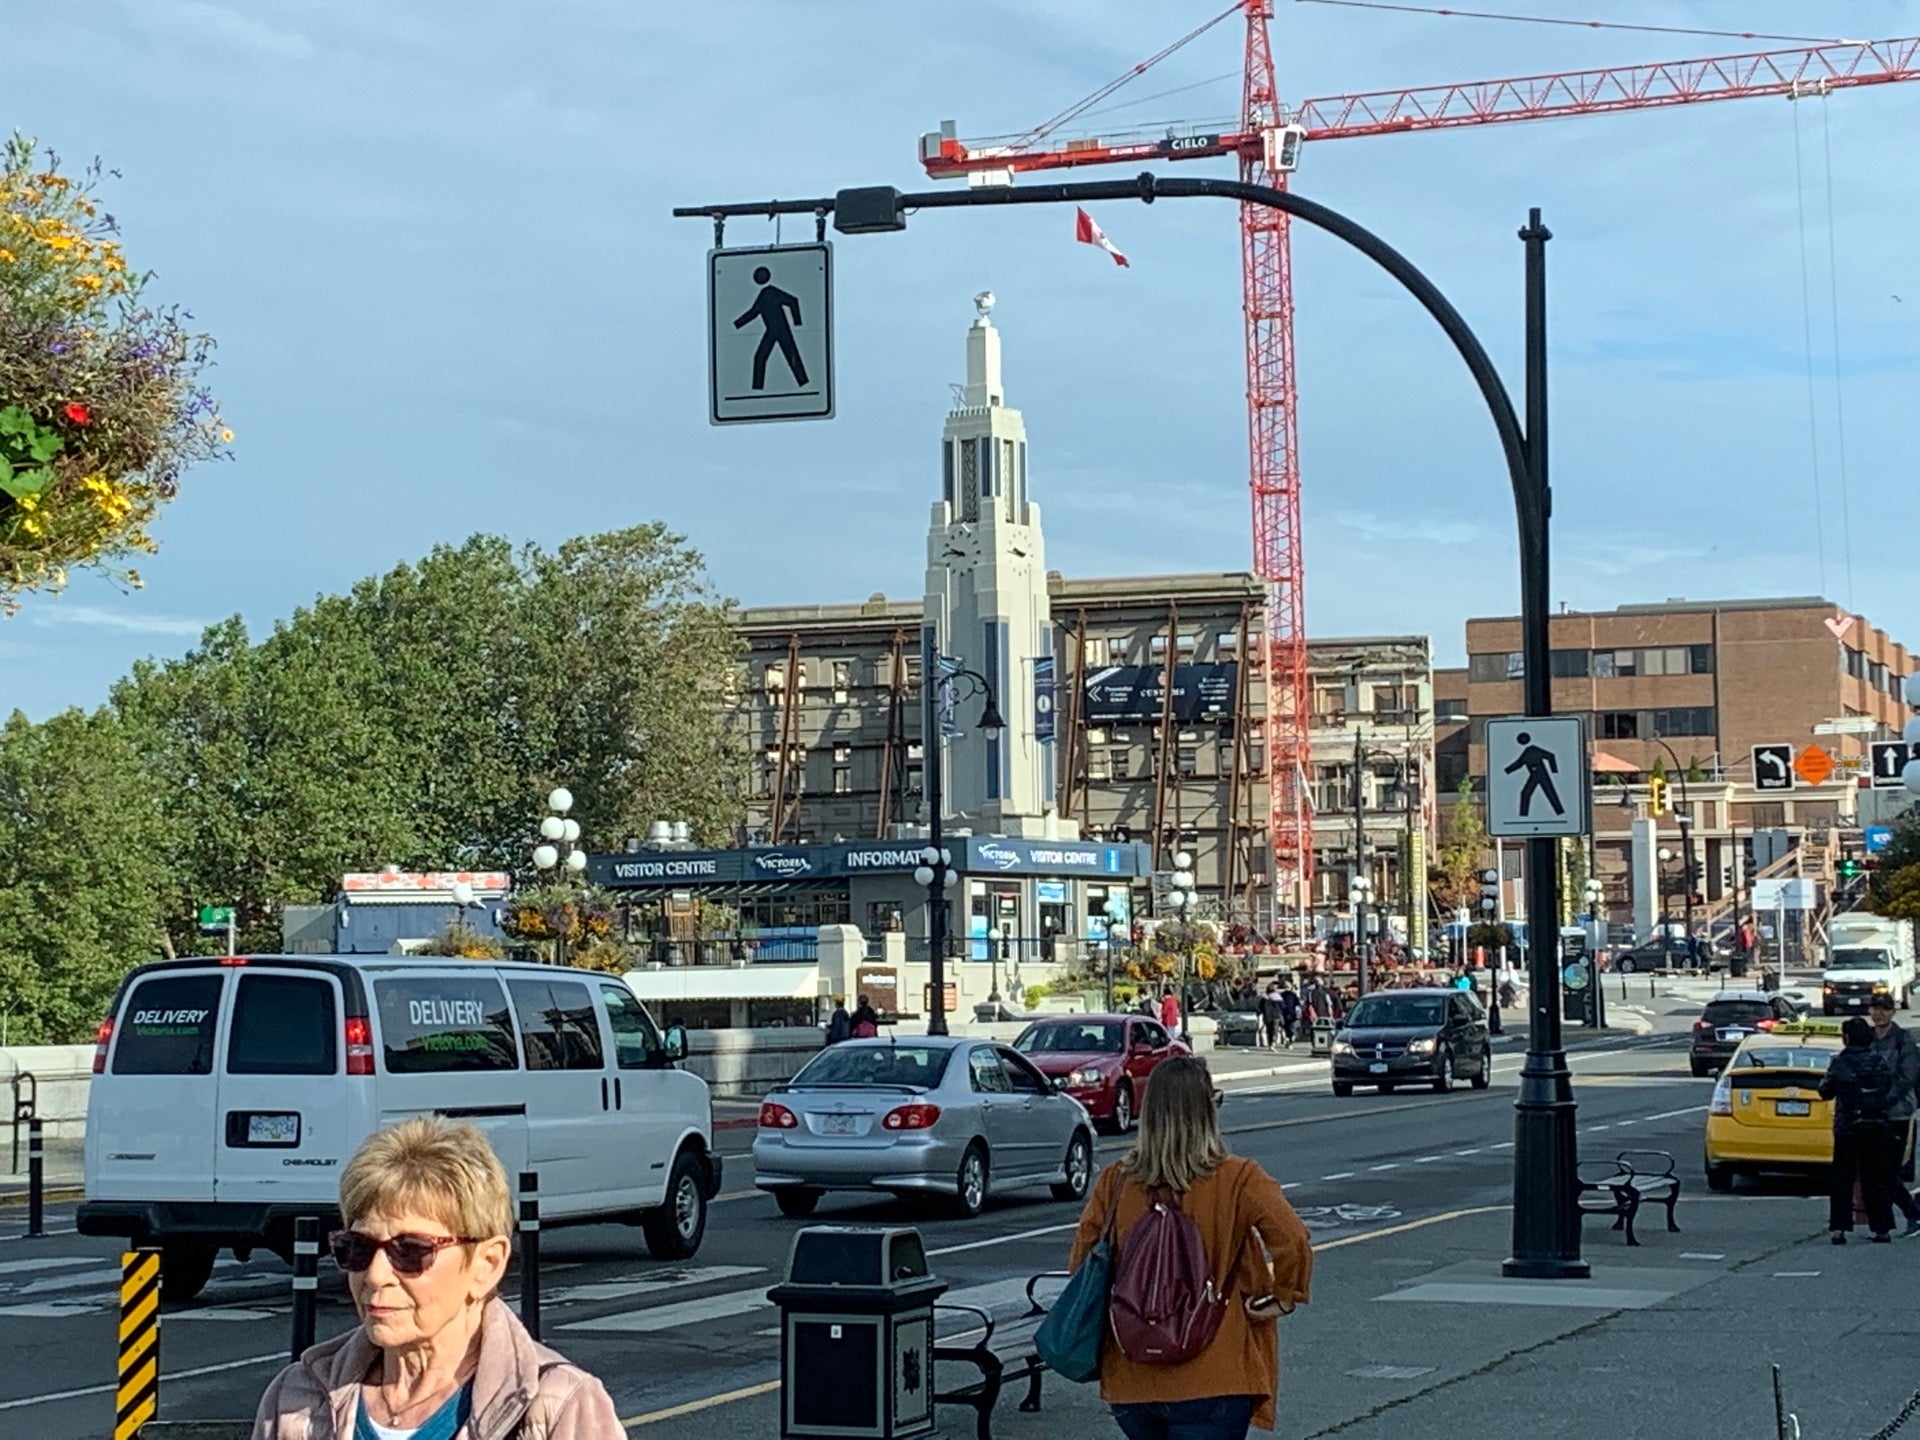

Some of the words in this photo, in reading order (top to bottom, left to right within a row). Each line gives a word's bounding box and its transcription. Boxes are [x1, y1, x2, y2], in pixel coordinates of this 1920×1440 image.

[1171, 137, 1208, 150] CIELO
[847, 848, 938, 867] INFORMAT
[1030, 850, 1063, 864] VISITOR
[1064, 852, 1097, 865] CENTRE
[615, 862, 664, 878] VISITOR
[666, 860, 716, 875] CENTRE
[133, 1009, 209, 1024] DELIVERY
[409, 1000, 483, 1025] DELIVERY
